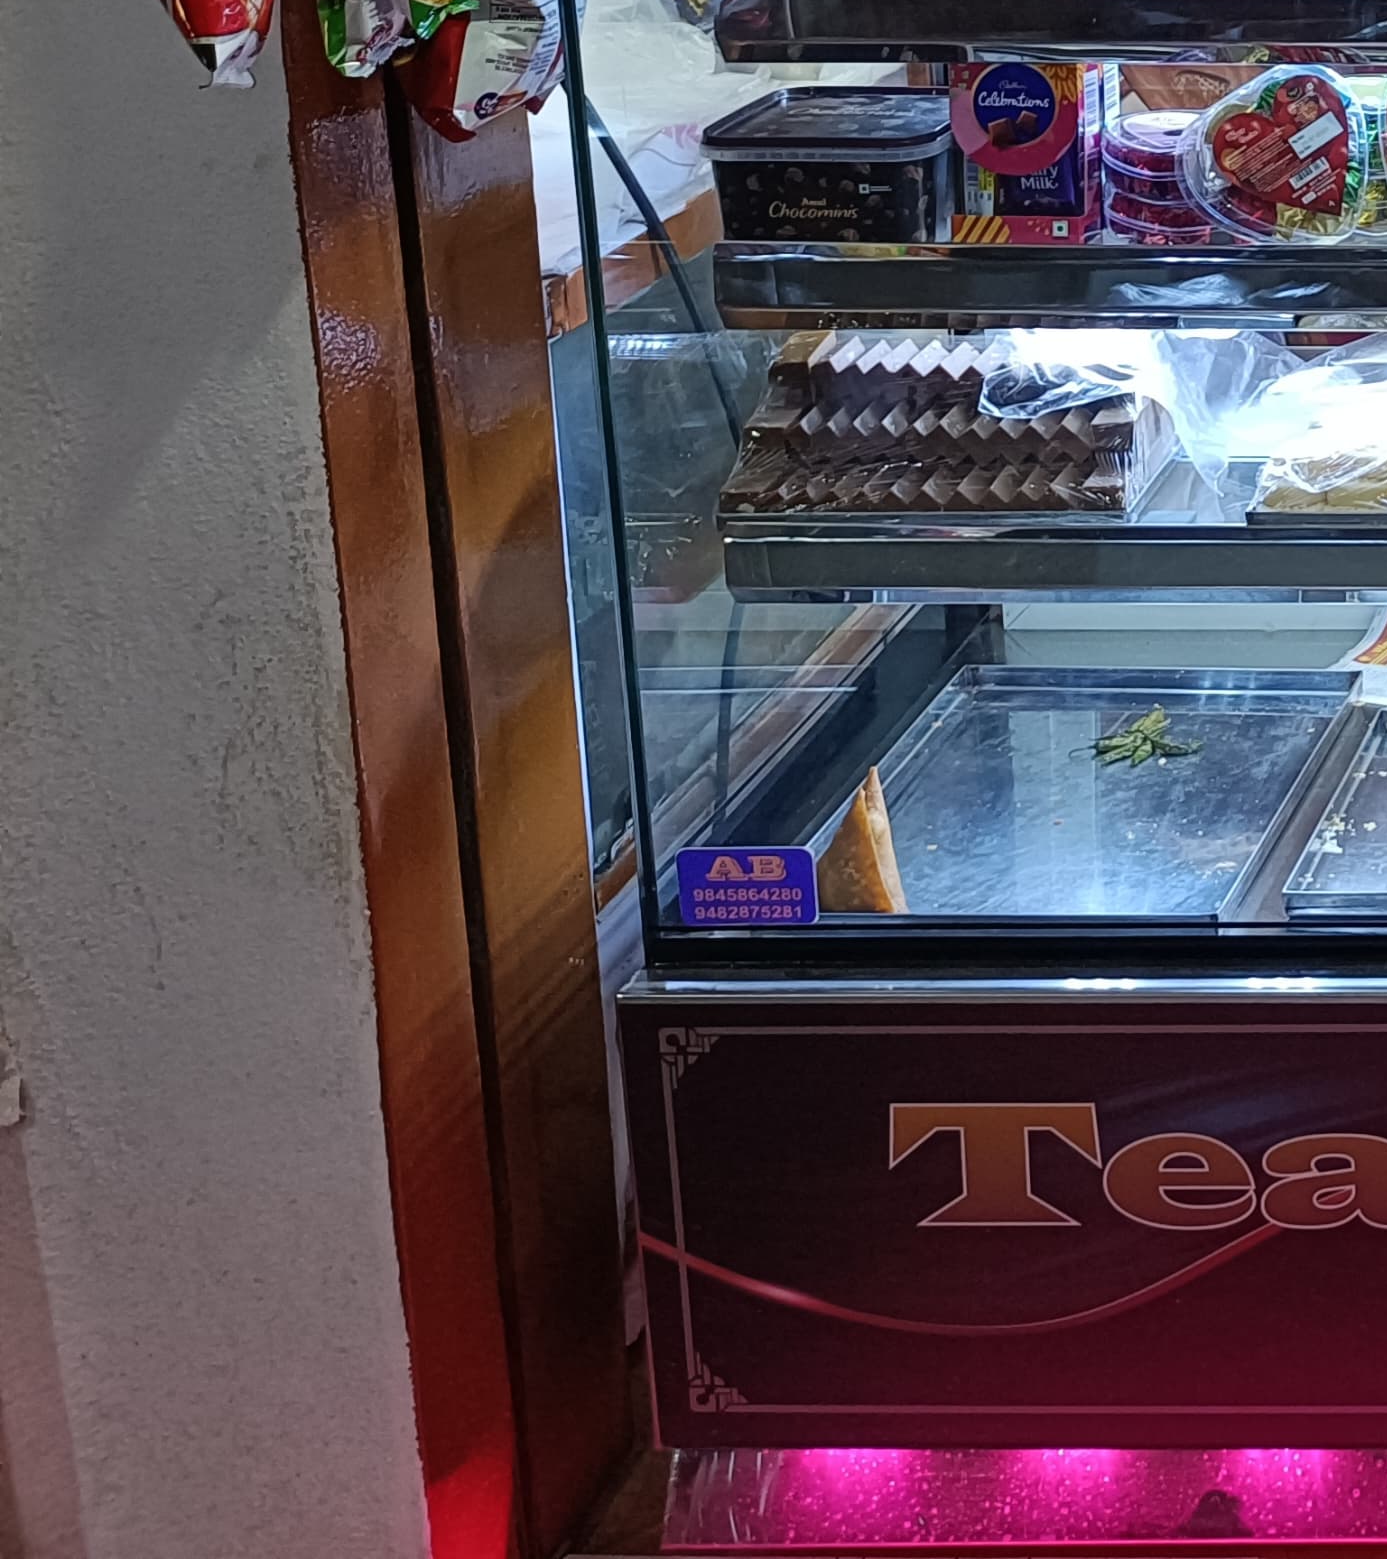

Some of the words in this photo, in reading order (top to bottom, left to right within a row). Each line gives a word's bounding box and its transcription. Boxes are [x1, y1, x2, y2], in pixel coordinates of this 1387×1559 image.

[977, 91, 1051, 109] Celebrations
[1021, 176, 1058, 191] Milk
[768, 200, 860, 221] Chocominis
[705, 855, 787, 881] AB
[693, 888, 803, 901] 9845864280
[694, 906, 802, 920] 9482875281
